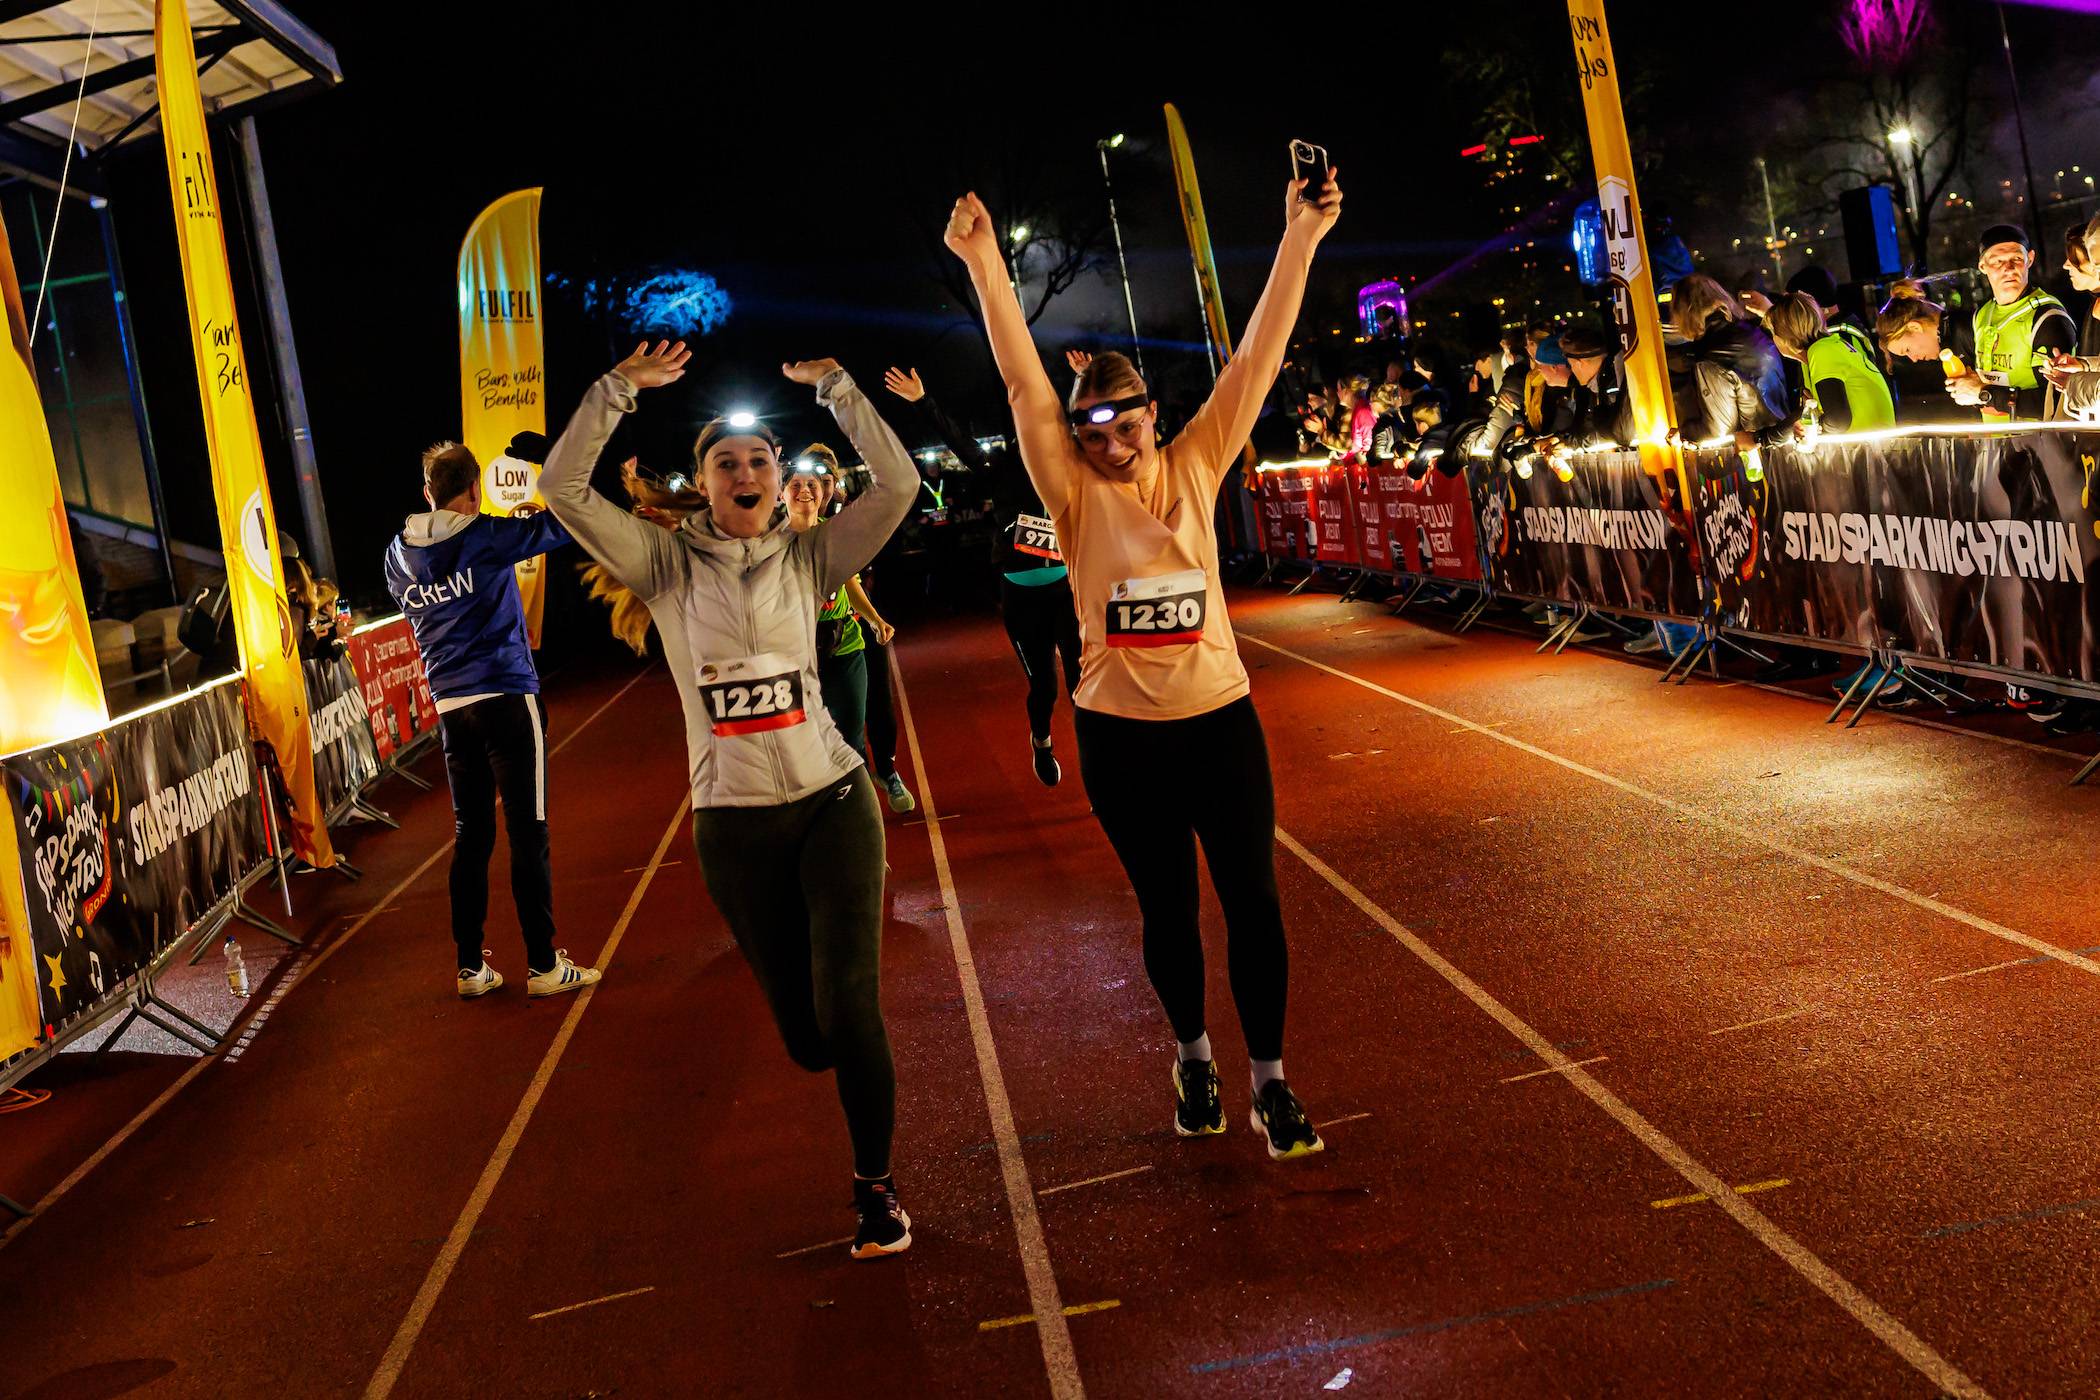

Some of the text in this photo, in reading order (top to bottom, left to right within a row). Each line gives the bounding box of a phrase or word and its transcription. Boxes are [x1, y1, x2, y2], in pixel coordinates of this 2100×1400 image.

[479, 290, 534, 318] FULFIL
[481, 388, 537, 411] Benefits
[501, 490, 526, 503] Sugar
[1782, 511, 2085, 583] STADSPARKNIGHTRUN
[403, 567, 475, 609] CREW
[1117, 598, 1201, 630] 1230
[711, 680, 793, 718] 1228
[35, 794, 98, 914] STADSPARK
[53, 819, 105, 948] NIGHTRUN
